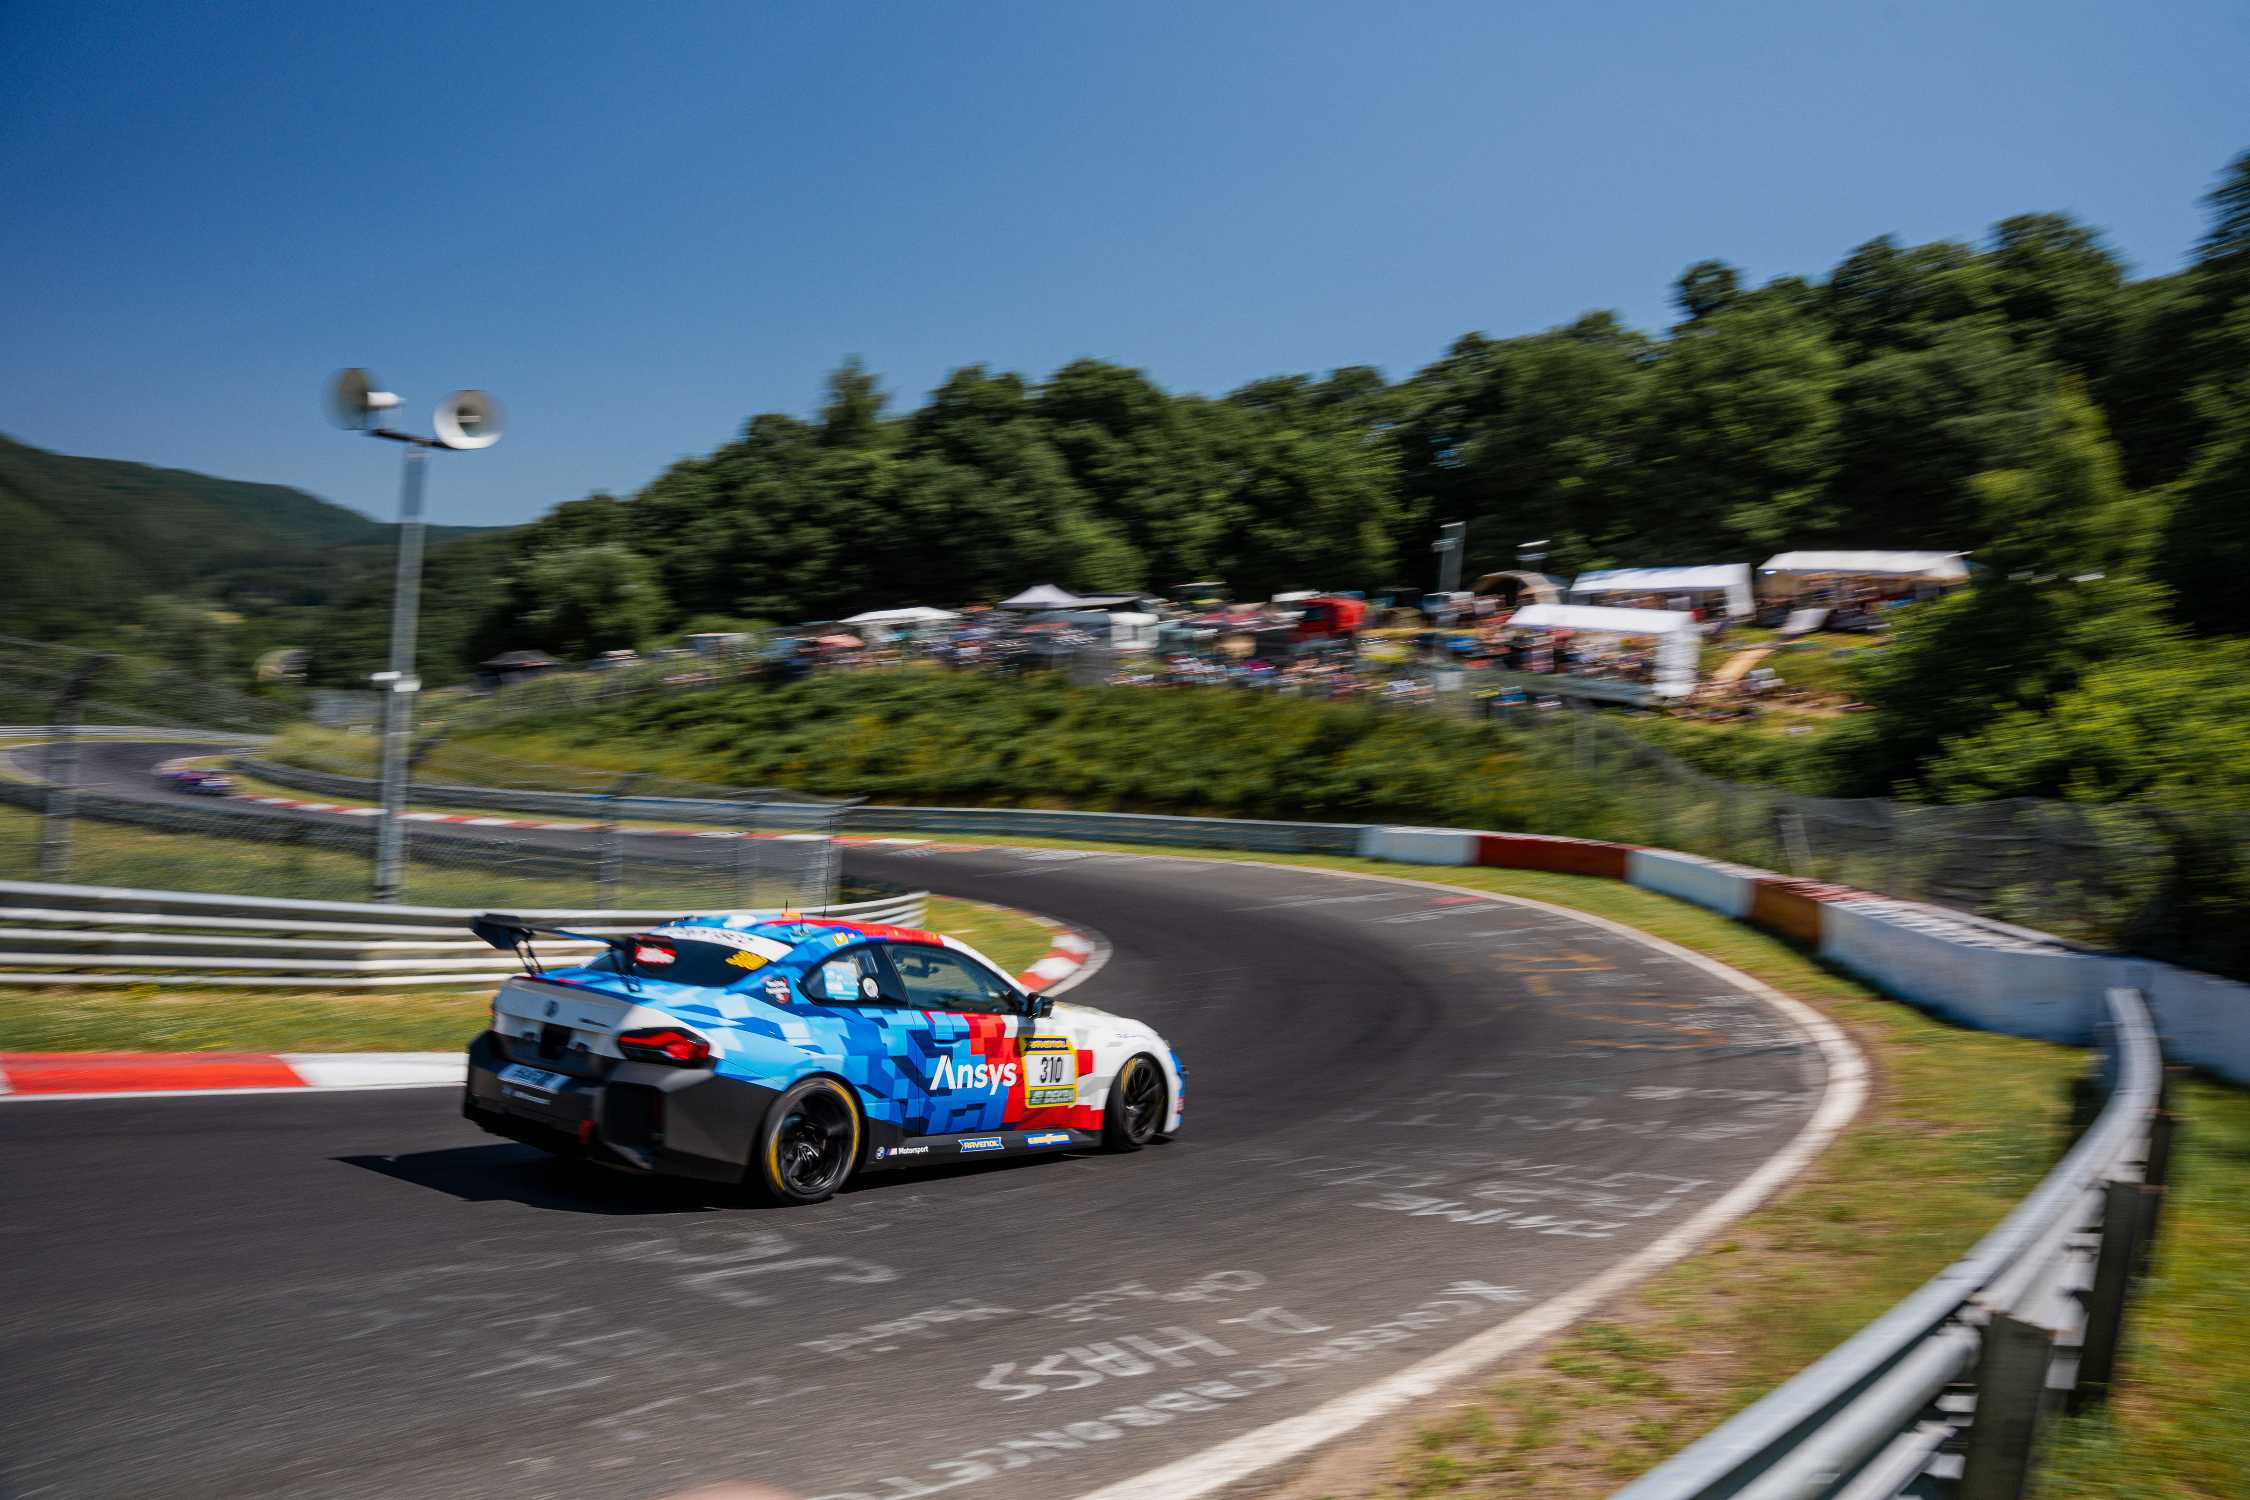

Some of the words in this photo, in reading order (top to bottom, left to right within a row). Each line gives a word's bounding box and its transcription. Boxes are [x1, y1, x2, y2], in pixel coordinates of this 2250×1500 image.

[930, 1055, 1017, 1095] Ansys
[1040, 1056, 1064, 1083] 310
[899, 1146, 929, 1155] Motorsport
